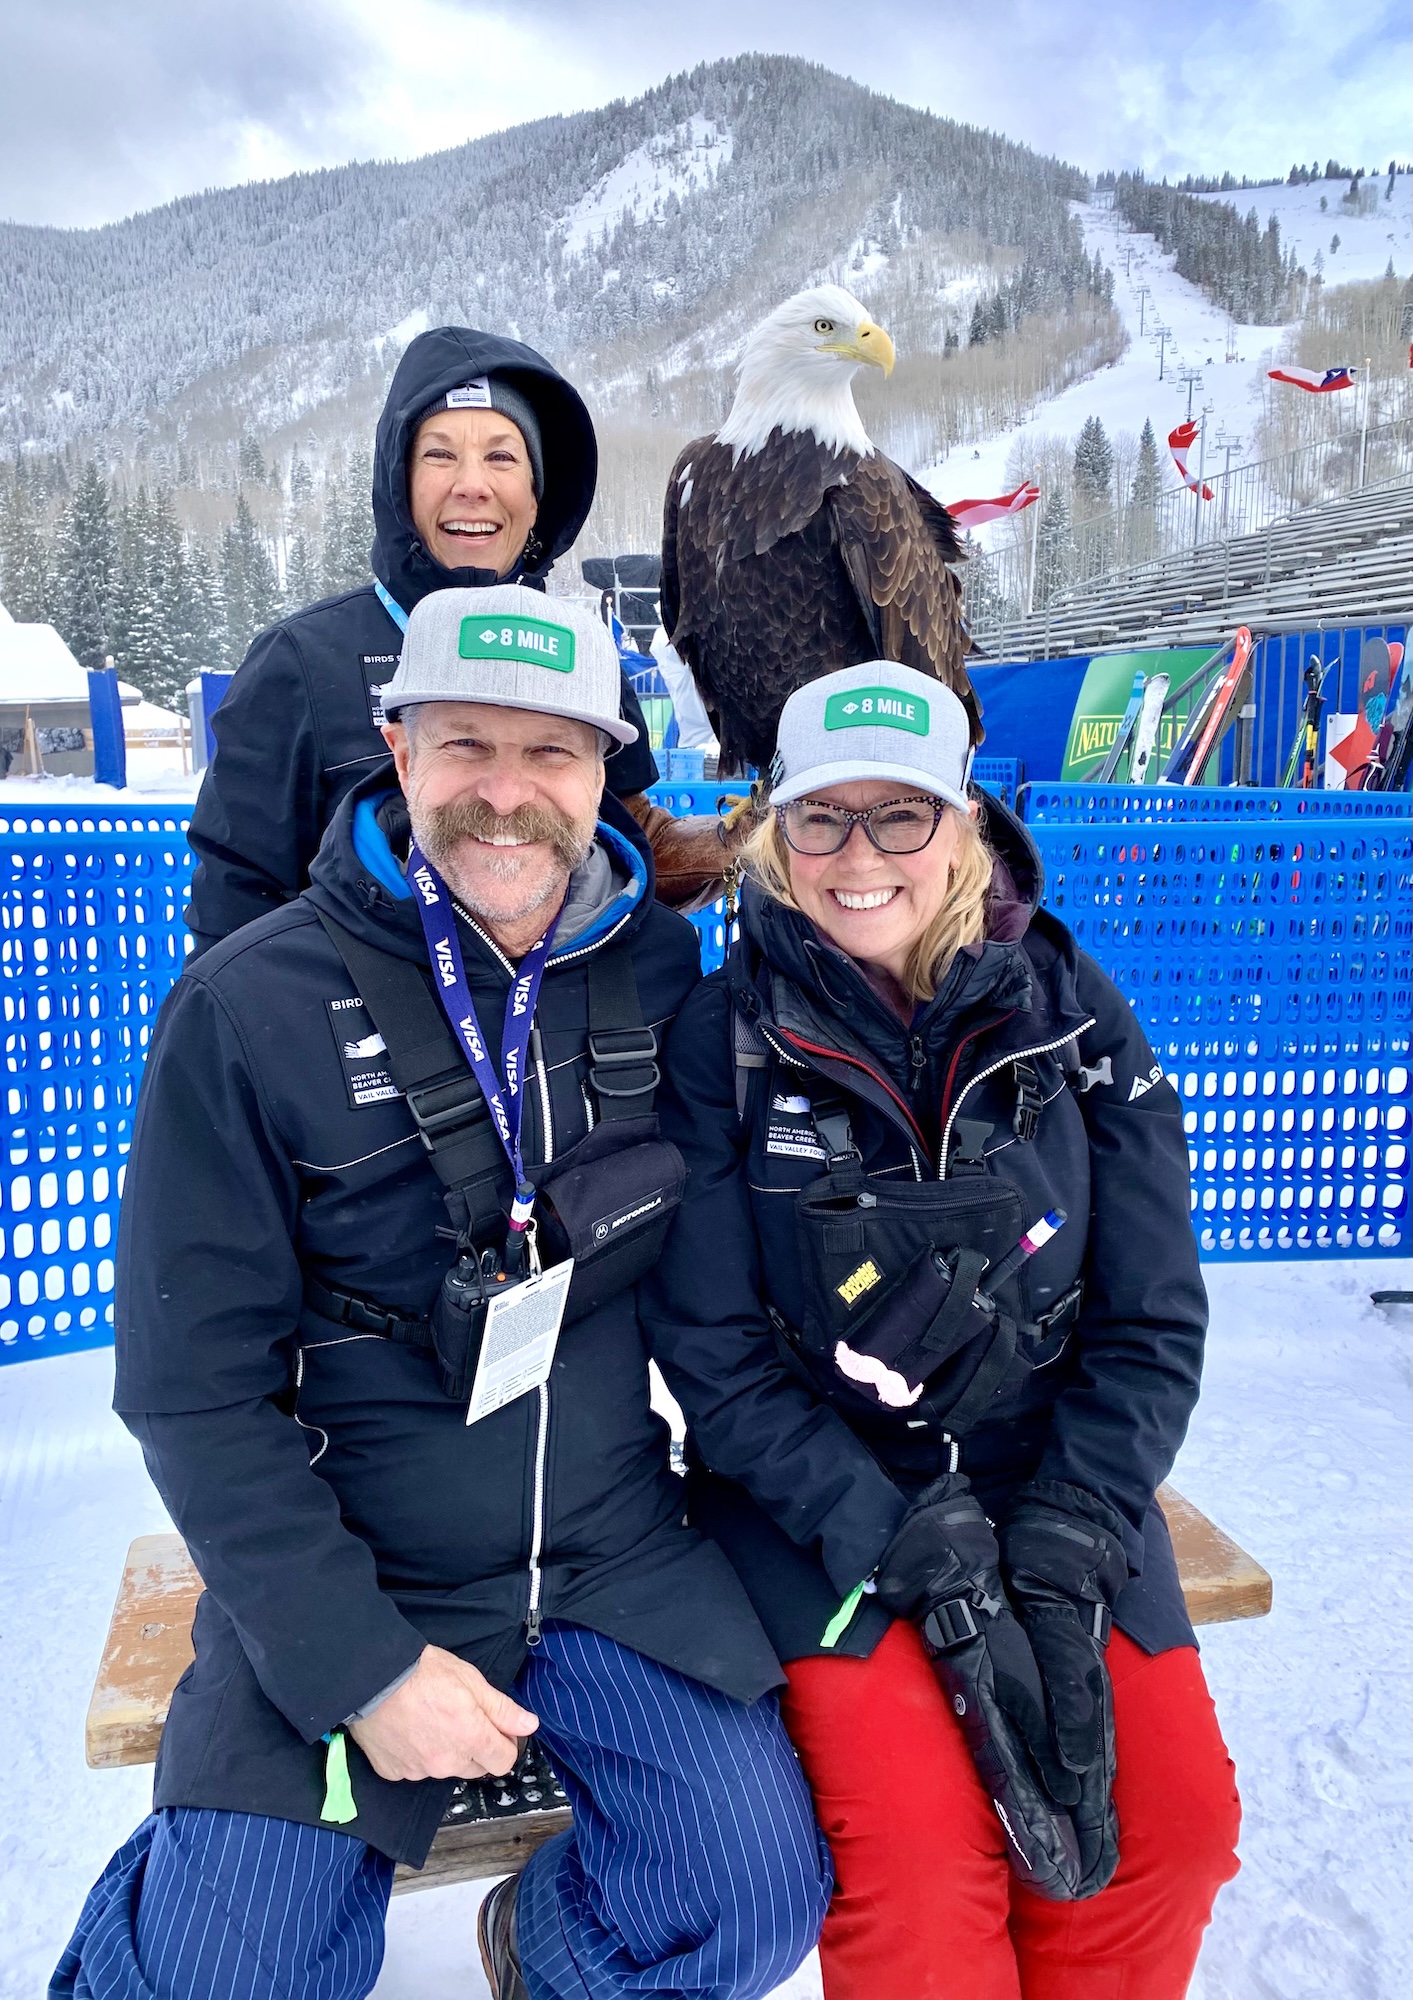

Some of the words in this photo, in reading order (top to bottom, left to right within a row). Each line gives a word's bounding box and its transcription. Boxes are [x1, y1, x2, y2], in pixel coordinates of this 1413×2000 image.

[500, 628, 513, 646] 8
[517, 629, 559, 656] MILE
[363, 655, 395, 664] BIRDS
[861, 698, 873, 714] 8
[877, 698, 915, 721] MILE
[413, 864, 440, 906] VISA
[434, 937, 457, 988] VISA
[513, 973, 534, 1017] VISA
[459, 1014, 486, 1063] VISA
[351, 1072, 376, 1082] NORTH
[352, 1078, 382, 1090] BEAVER
[505, 1046, 519, 1097] VISA
[357, 1091, 375, 1100] VAIL
[490, 1093, 510, 1141] VISA
[768, 1125, 791, 1133] NORTH
[768, 1132, 794, 1141] BEAVER
[769, 1143, 784, 1151] VAIL
[784, 1145, 808, 1153] VALLEY
[612, 1196, 662, 1229] MOTOROLA
